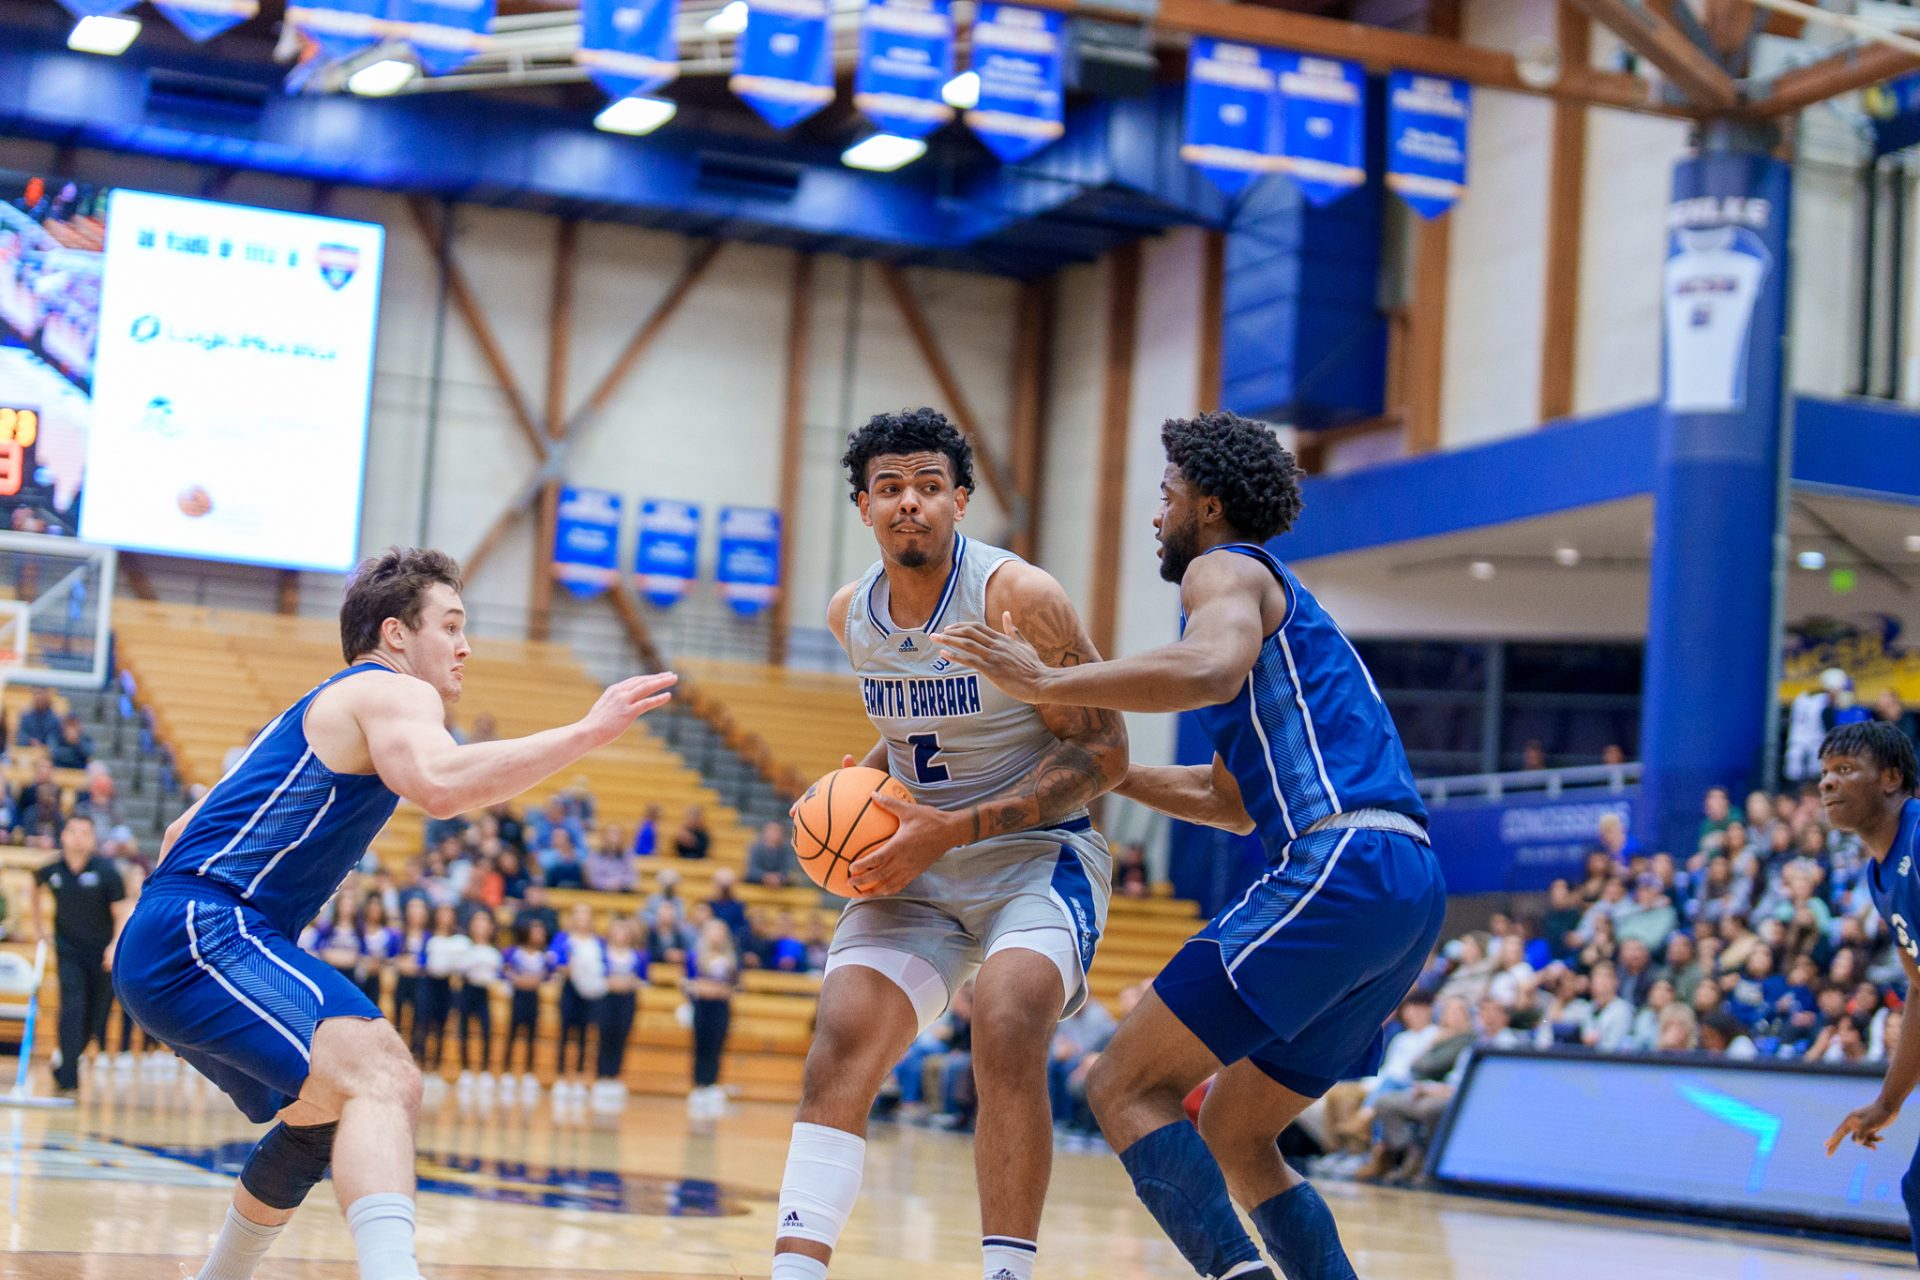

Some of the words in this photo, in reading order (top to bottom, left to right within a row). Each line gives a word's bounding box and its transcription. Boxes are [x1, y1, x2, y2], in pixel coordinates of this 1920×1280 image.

[863, 677, 908, 719] SANTA
[909, 673, 983, 718] BARBARA
[907, 732, 951, 783] 2
